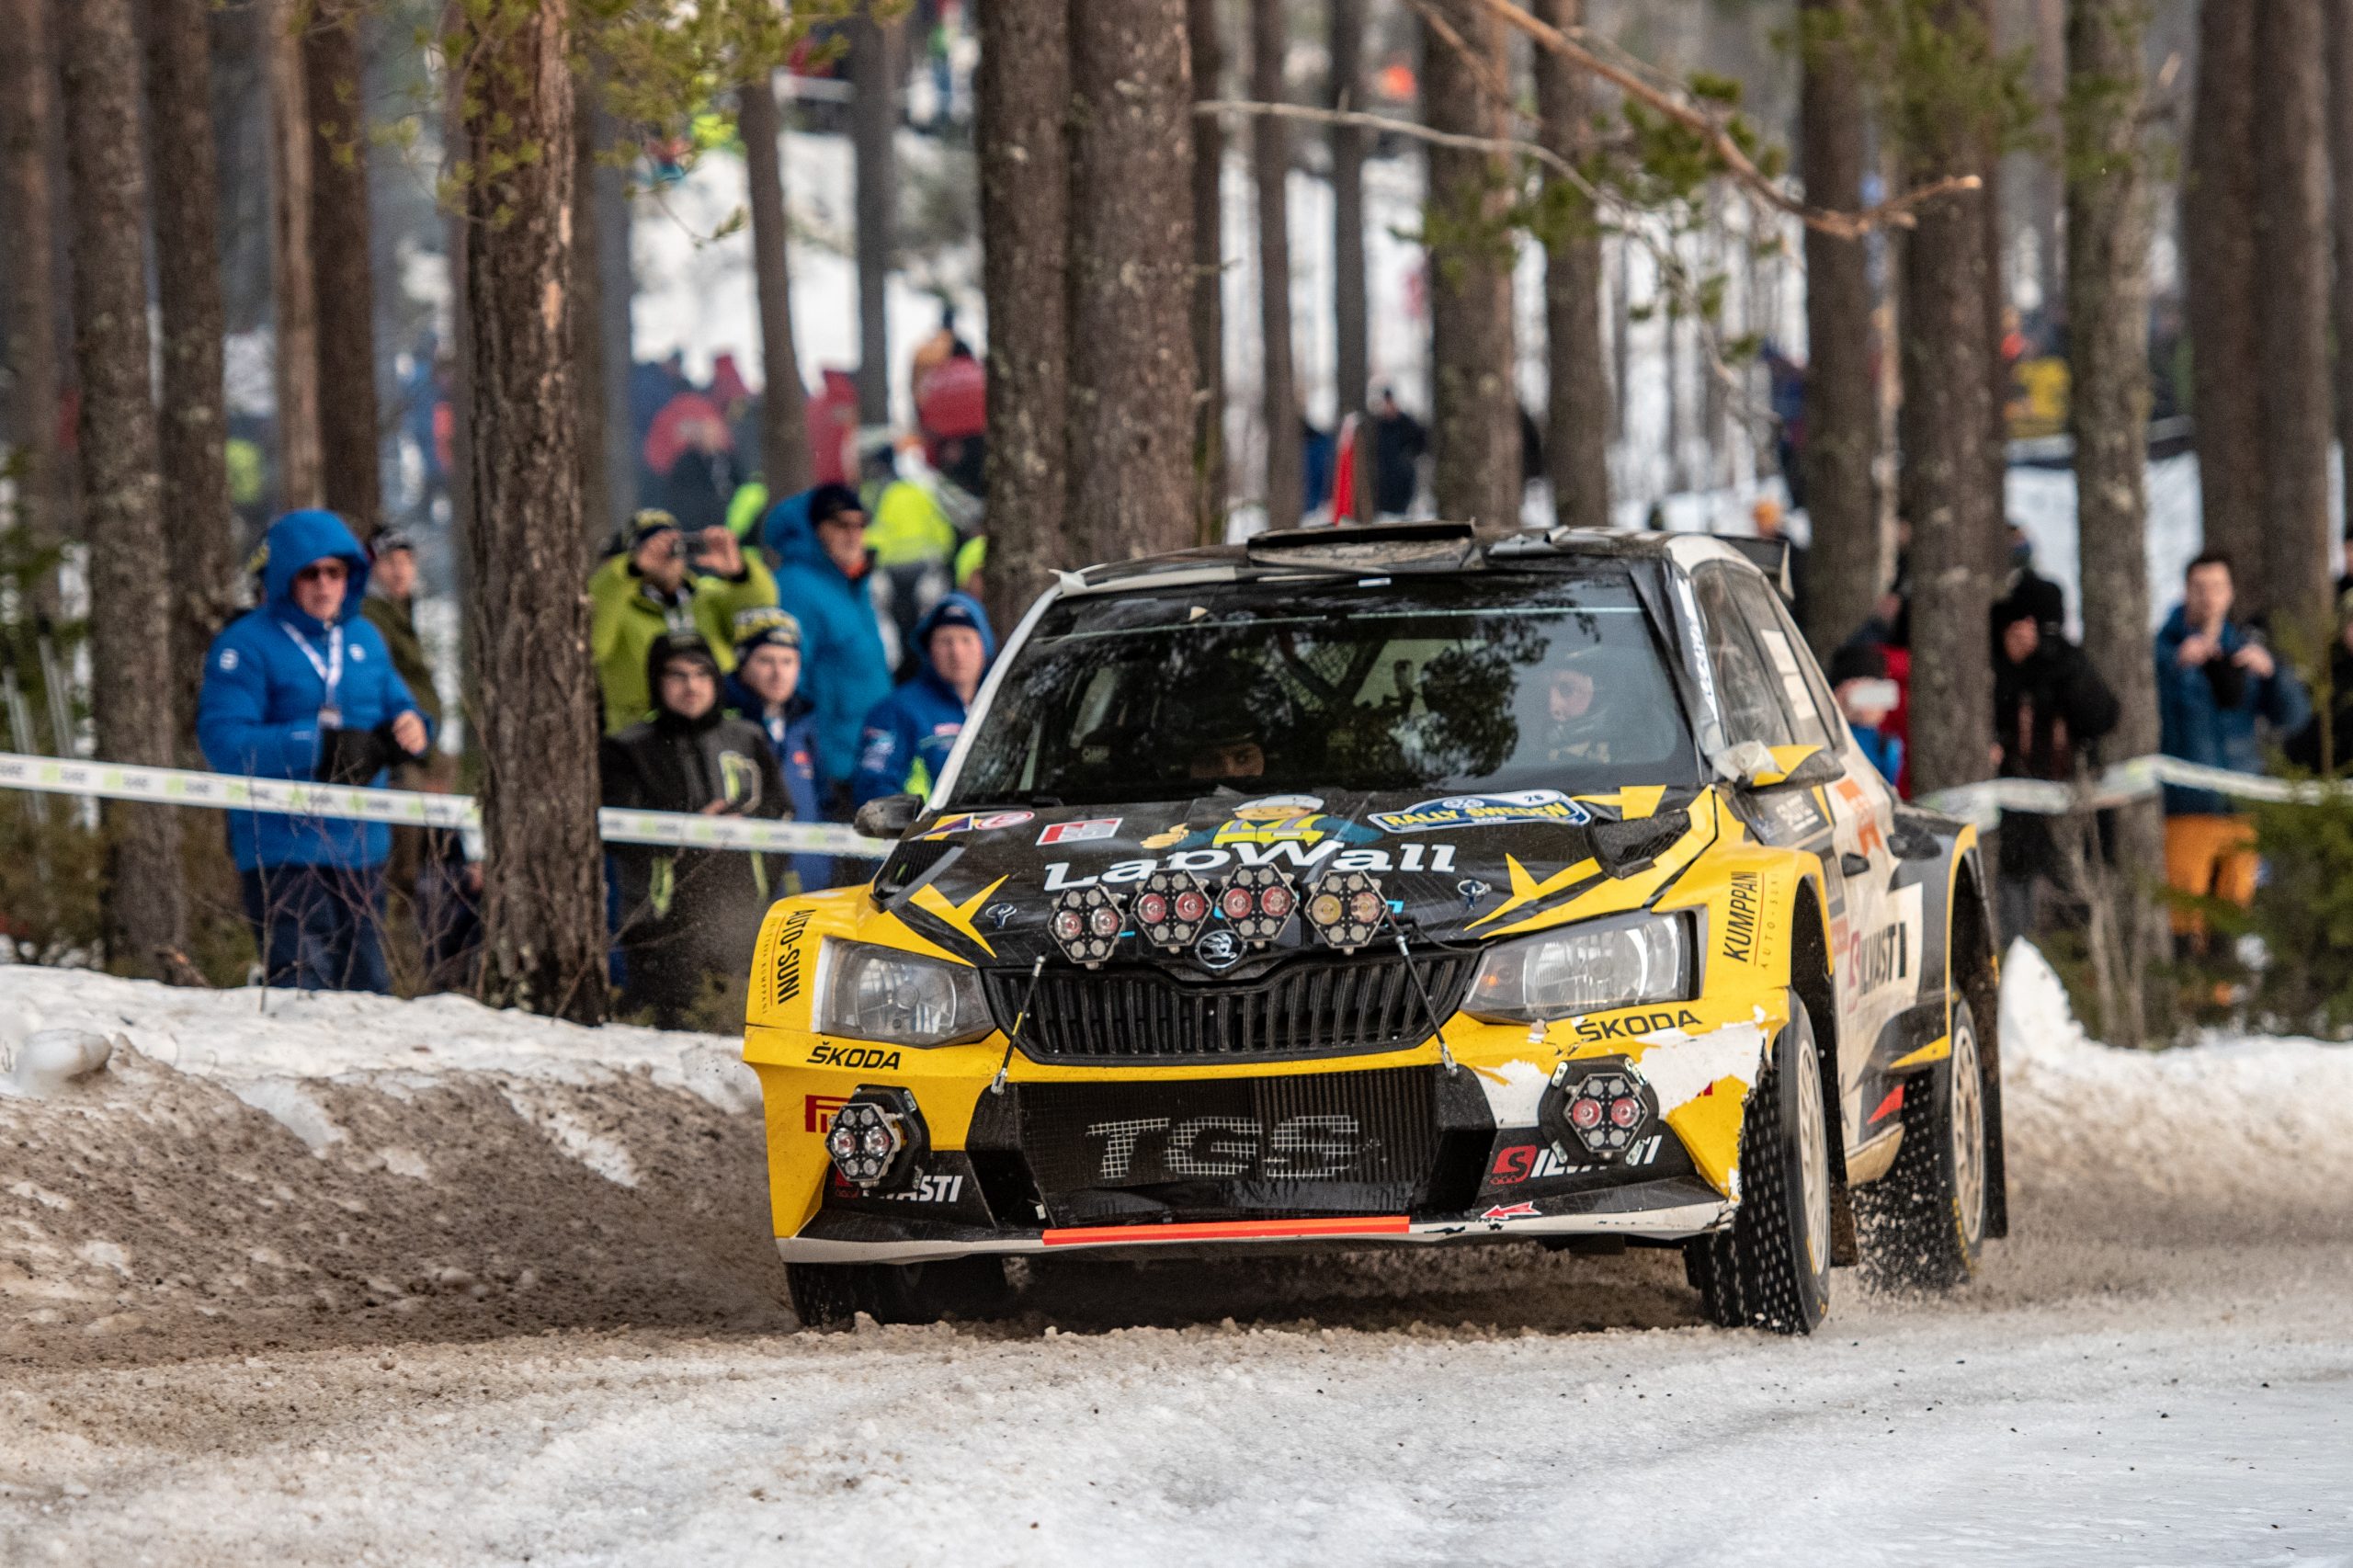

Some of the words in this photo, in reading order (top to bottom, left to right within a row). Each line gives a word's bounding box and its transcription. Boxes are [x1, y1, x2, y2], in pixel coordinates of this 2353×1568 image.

[1381, 809, 1460, 827] RALLY
[1465, 801, 1571, 819] SWEDEN
[1044, 840, 1456, 892] LapWall
[1722, 870, 1757, 964] KUMPPANI
[778, 909, 817, 1006] AUTO-SUNI
[806, 1040, 901, 1071] ŠKODA
[1083, 1114, 1359, 1179] TGS
